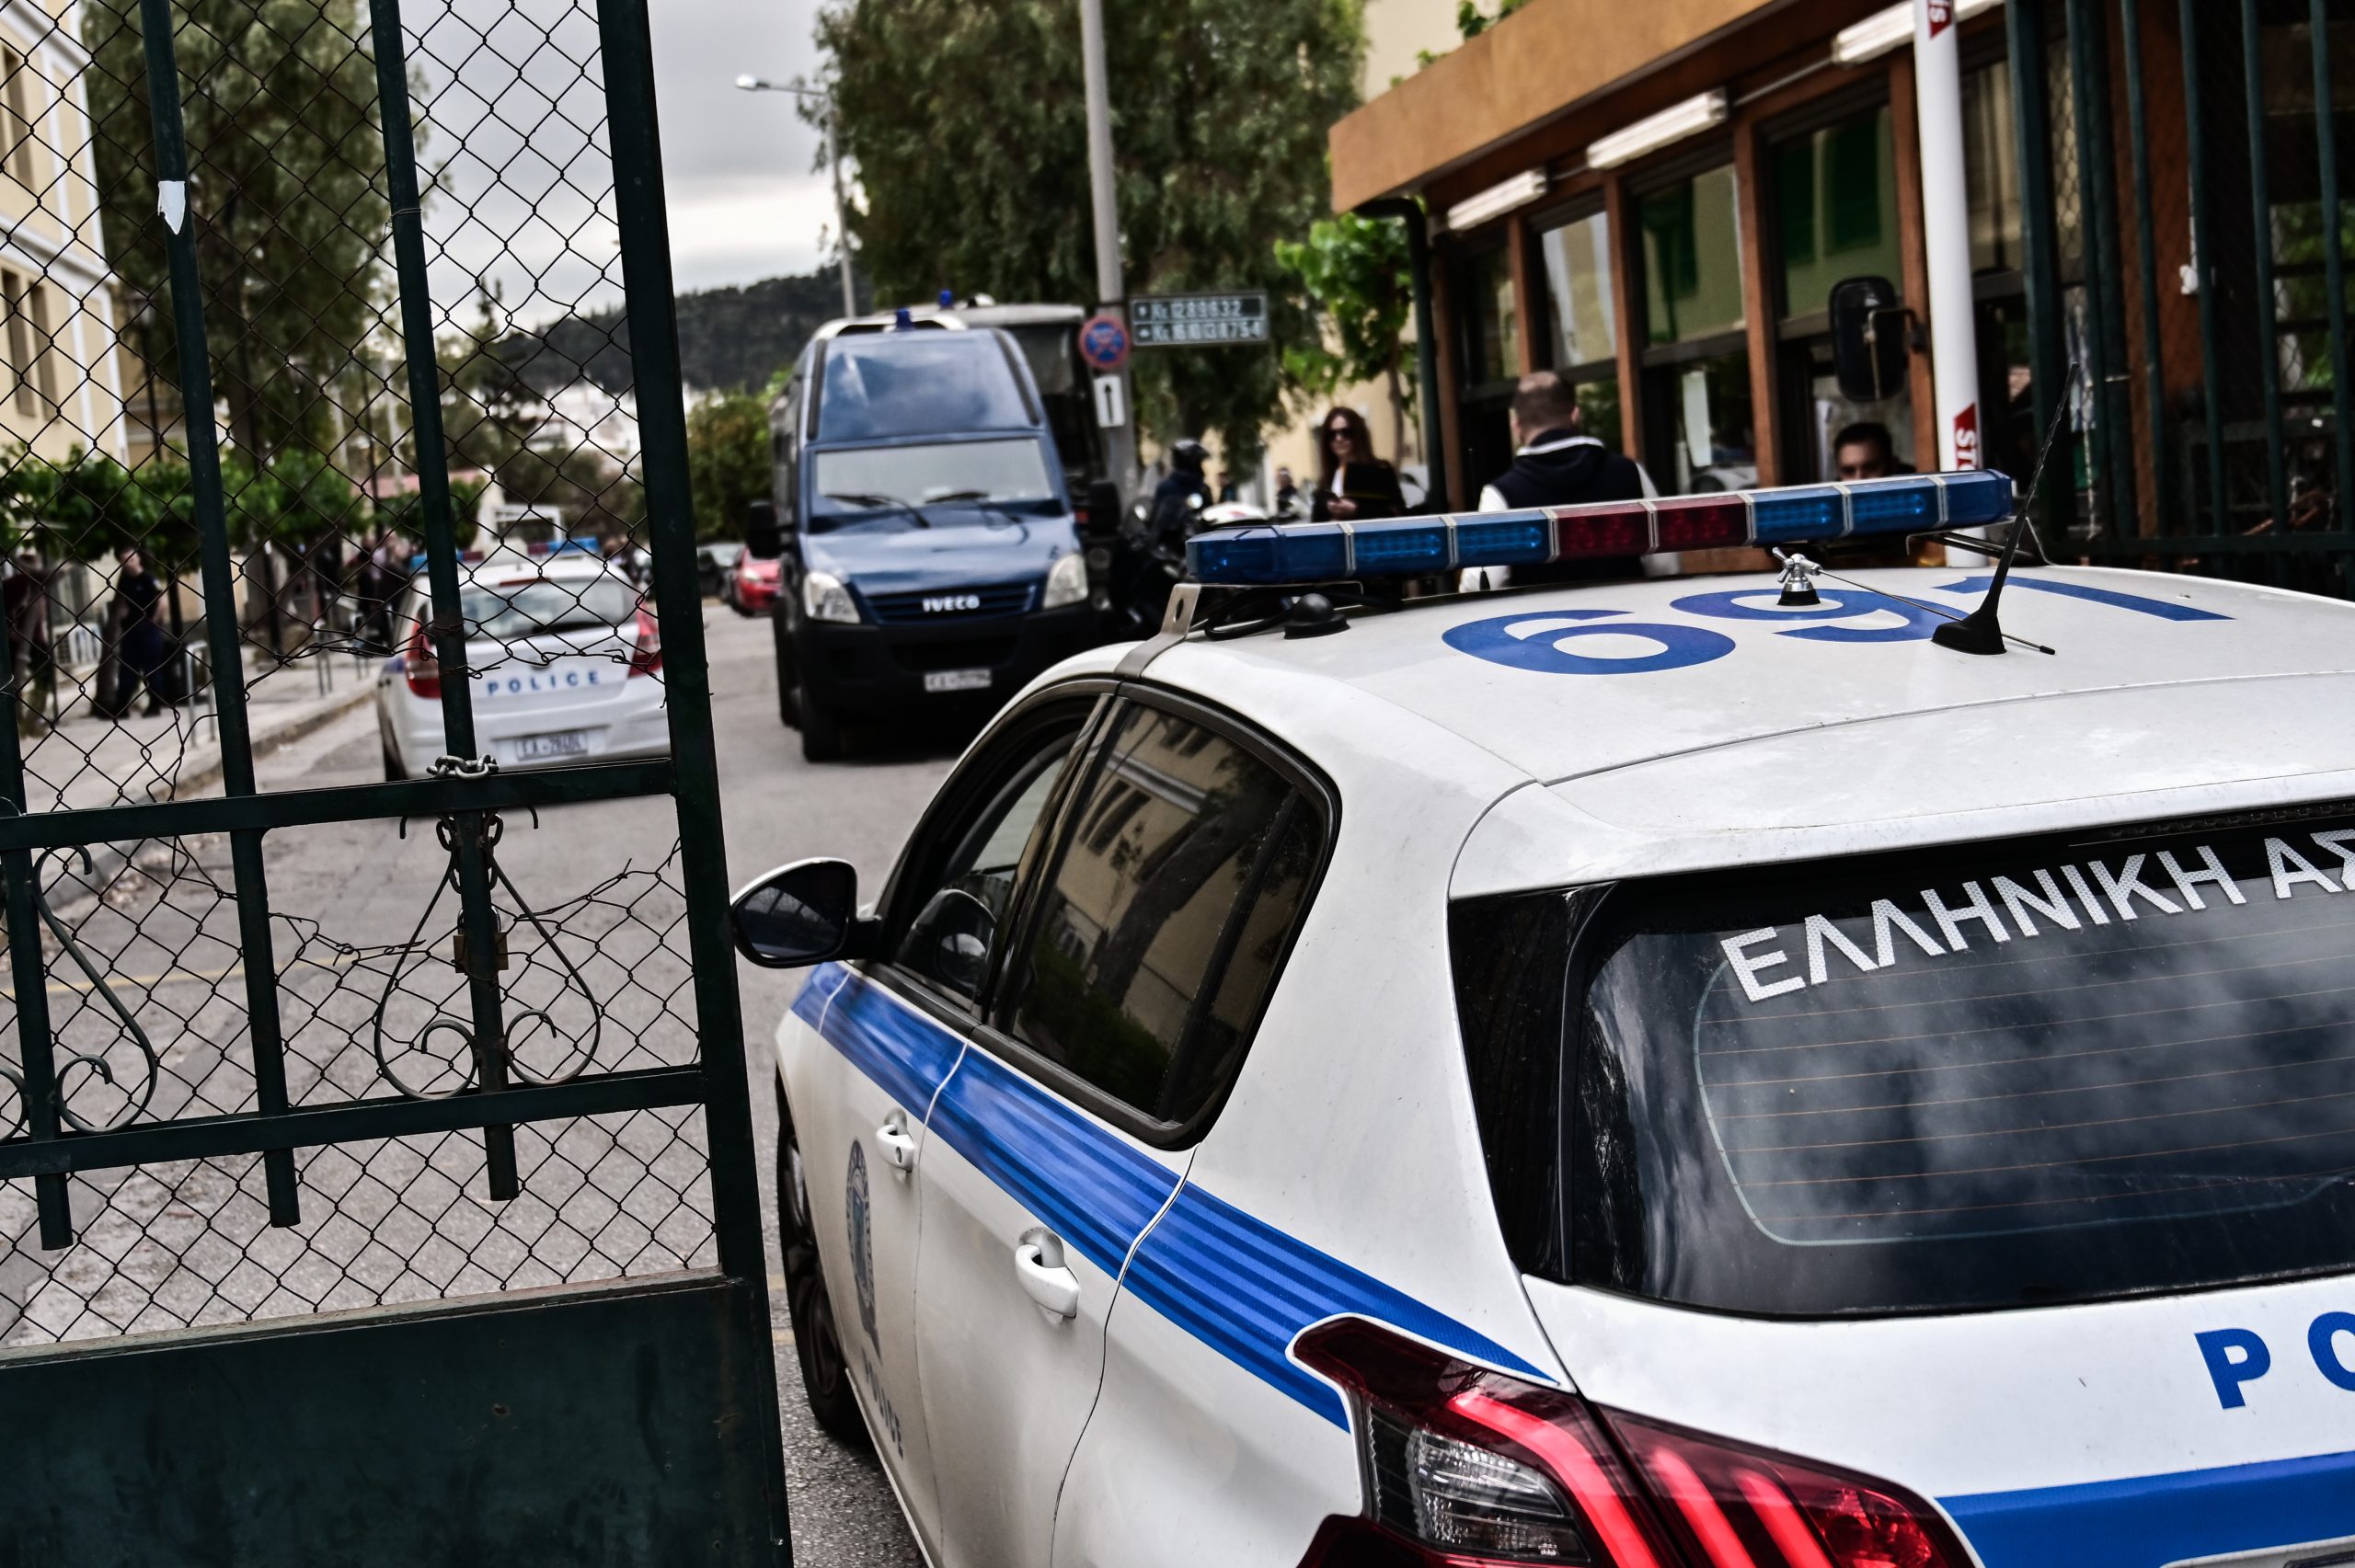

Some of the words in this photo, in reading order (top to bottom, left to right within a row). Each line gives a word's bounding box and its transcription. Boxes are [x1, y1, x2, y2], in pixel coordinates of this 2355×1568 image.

[923, 595, 980, 612] IVECO
[488, 670, 600, 696] POLICE
[1719, 845, 2247, 1004] ΕΛΛΗΝΙΚΗ
